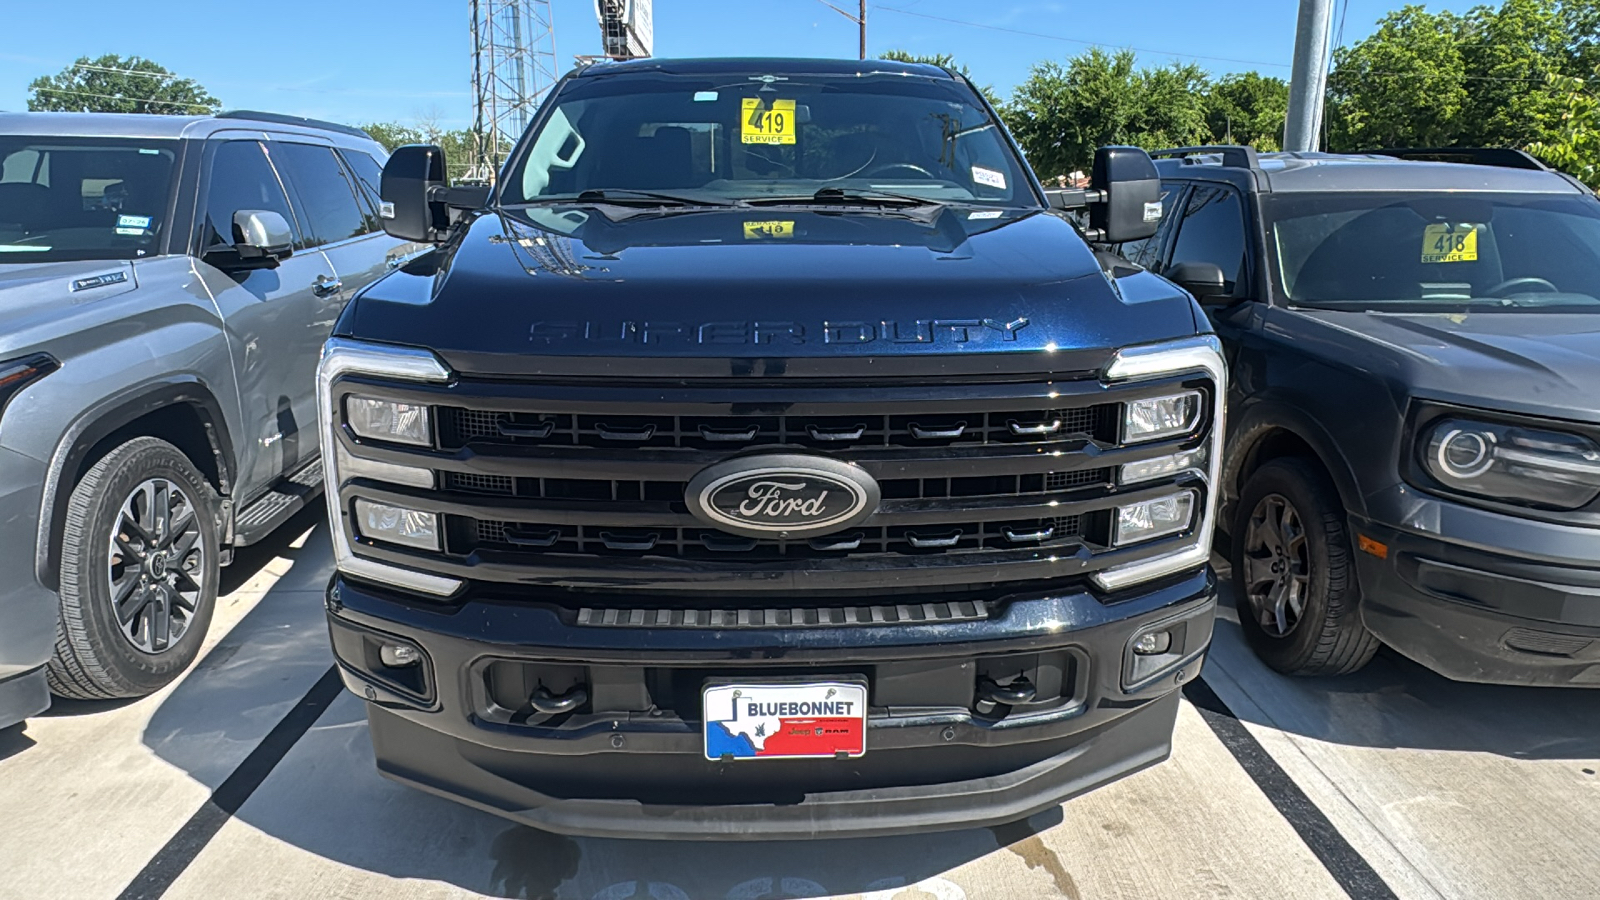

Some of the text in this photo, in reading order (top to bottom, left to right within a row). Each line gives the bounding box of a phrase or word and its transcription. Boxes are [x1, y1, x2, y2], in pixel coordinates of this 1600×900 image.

[754, 112, 784, 134] 419
[1434, 234, 1465, 252] 418
[1423, 254, 1464, 262] SERVICE
[529, 318, 1030, 345] SUPER DUTY
[739, 481, 828, 517] Ford
[748, 702, 854, 716] BLUEBONNET
